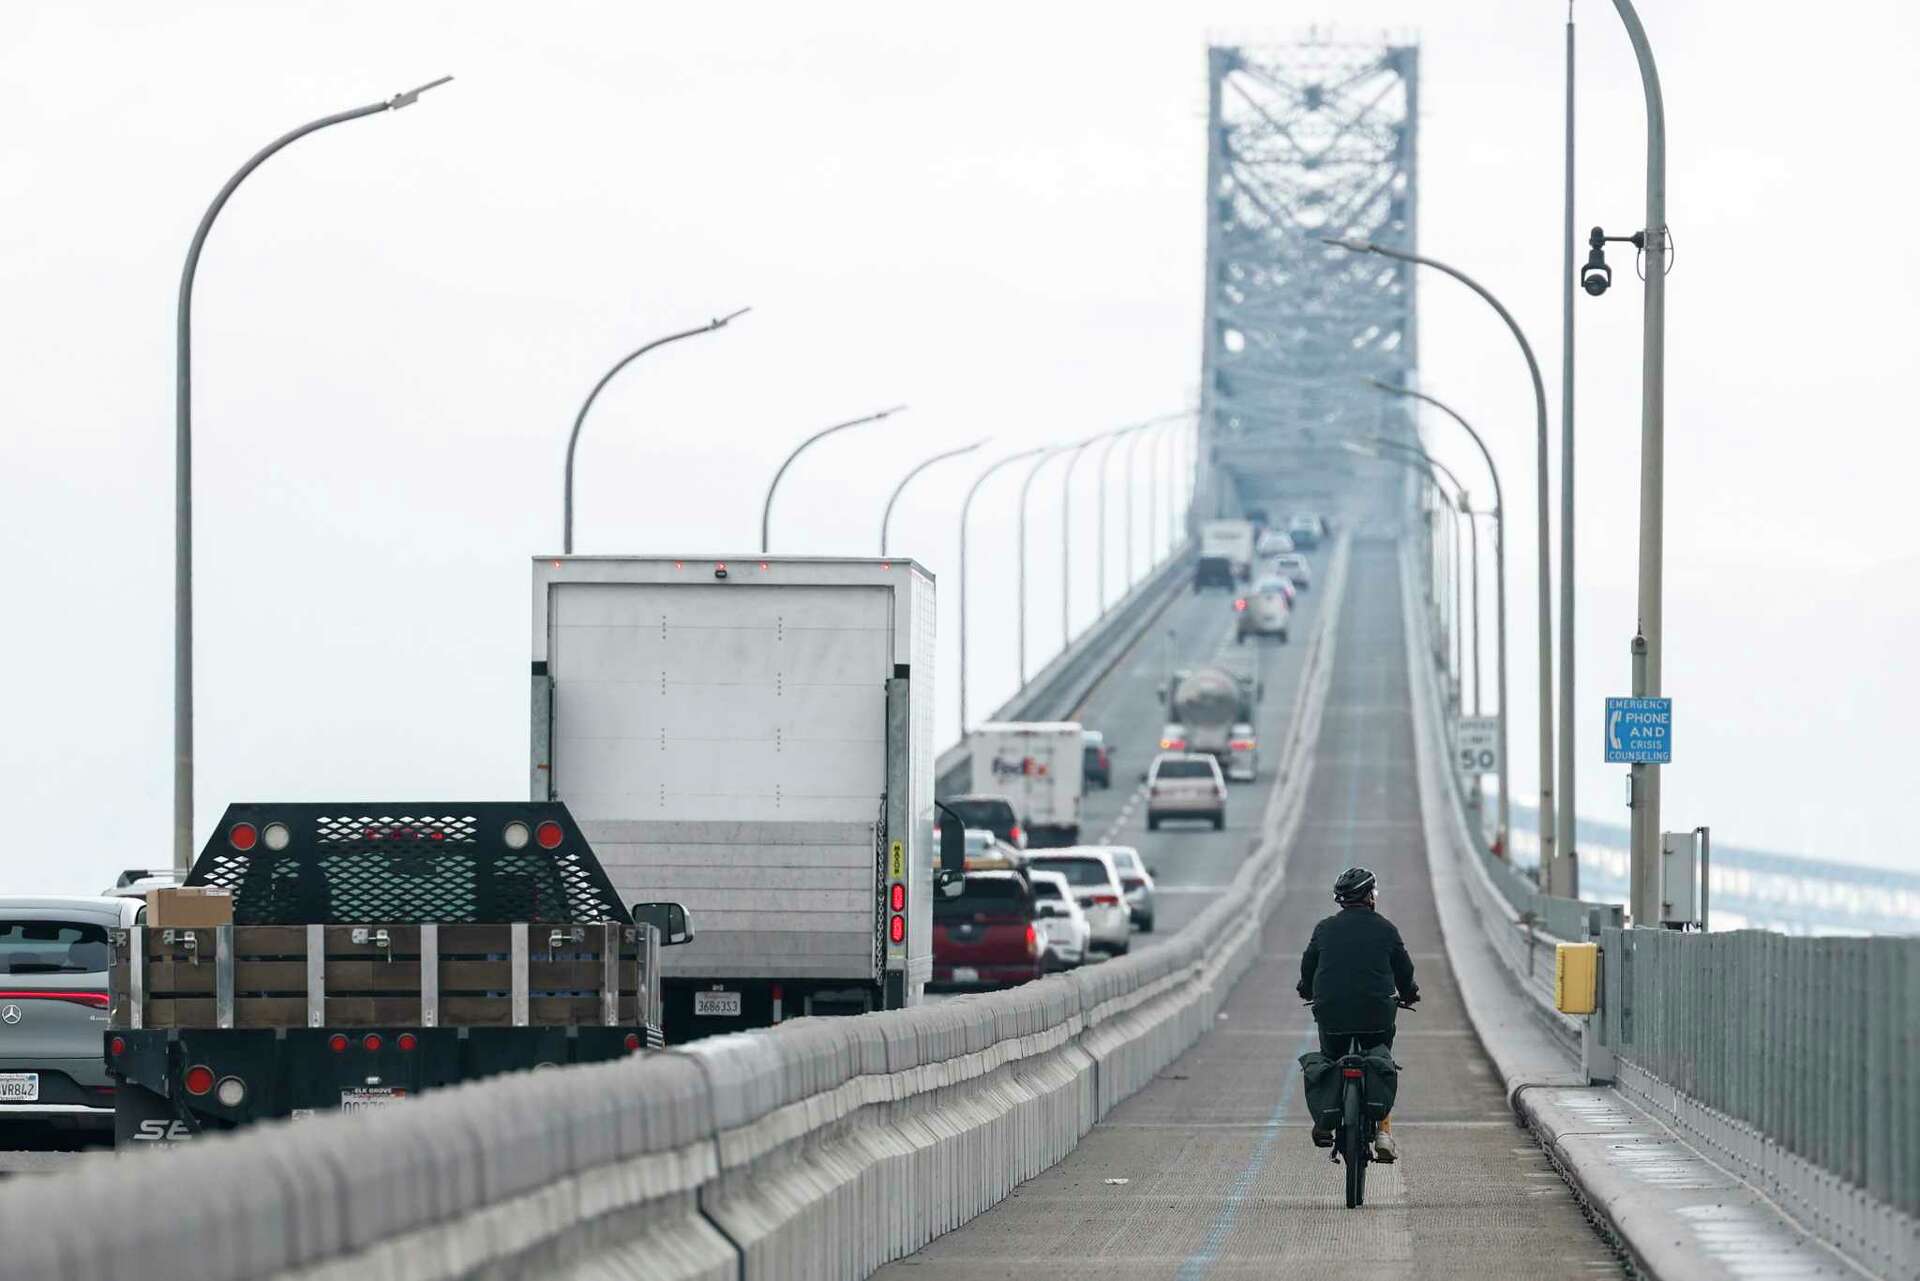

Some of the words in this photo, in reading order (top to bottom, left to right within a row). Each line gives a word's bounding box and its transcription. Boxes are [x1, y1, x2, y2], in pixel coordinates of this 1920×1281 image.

[1609, 700, 1668, 709] EMERGENCY
[1626, 712, 1669, 724] PHONE
[1631, 727, 1665, 737] AND
[1631, 740, 1663, 750] CRISIS
[1460, 749, 1495, 769] 50
[1609, 751, 1670, 761] COUNSELING
[0, 1083, 35, 1096] VR842
